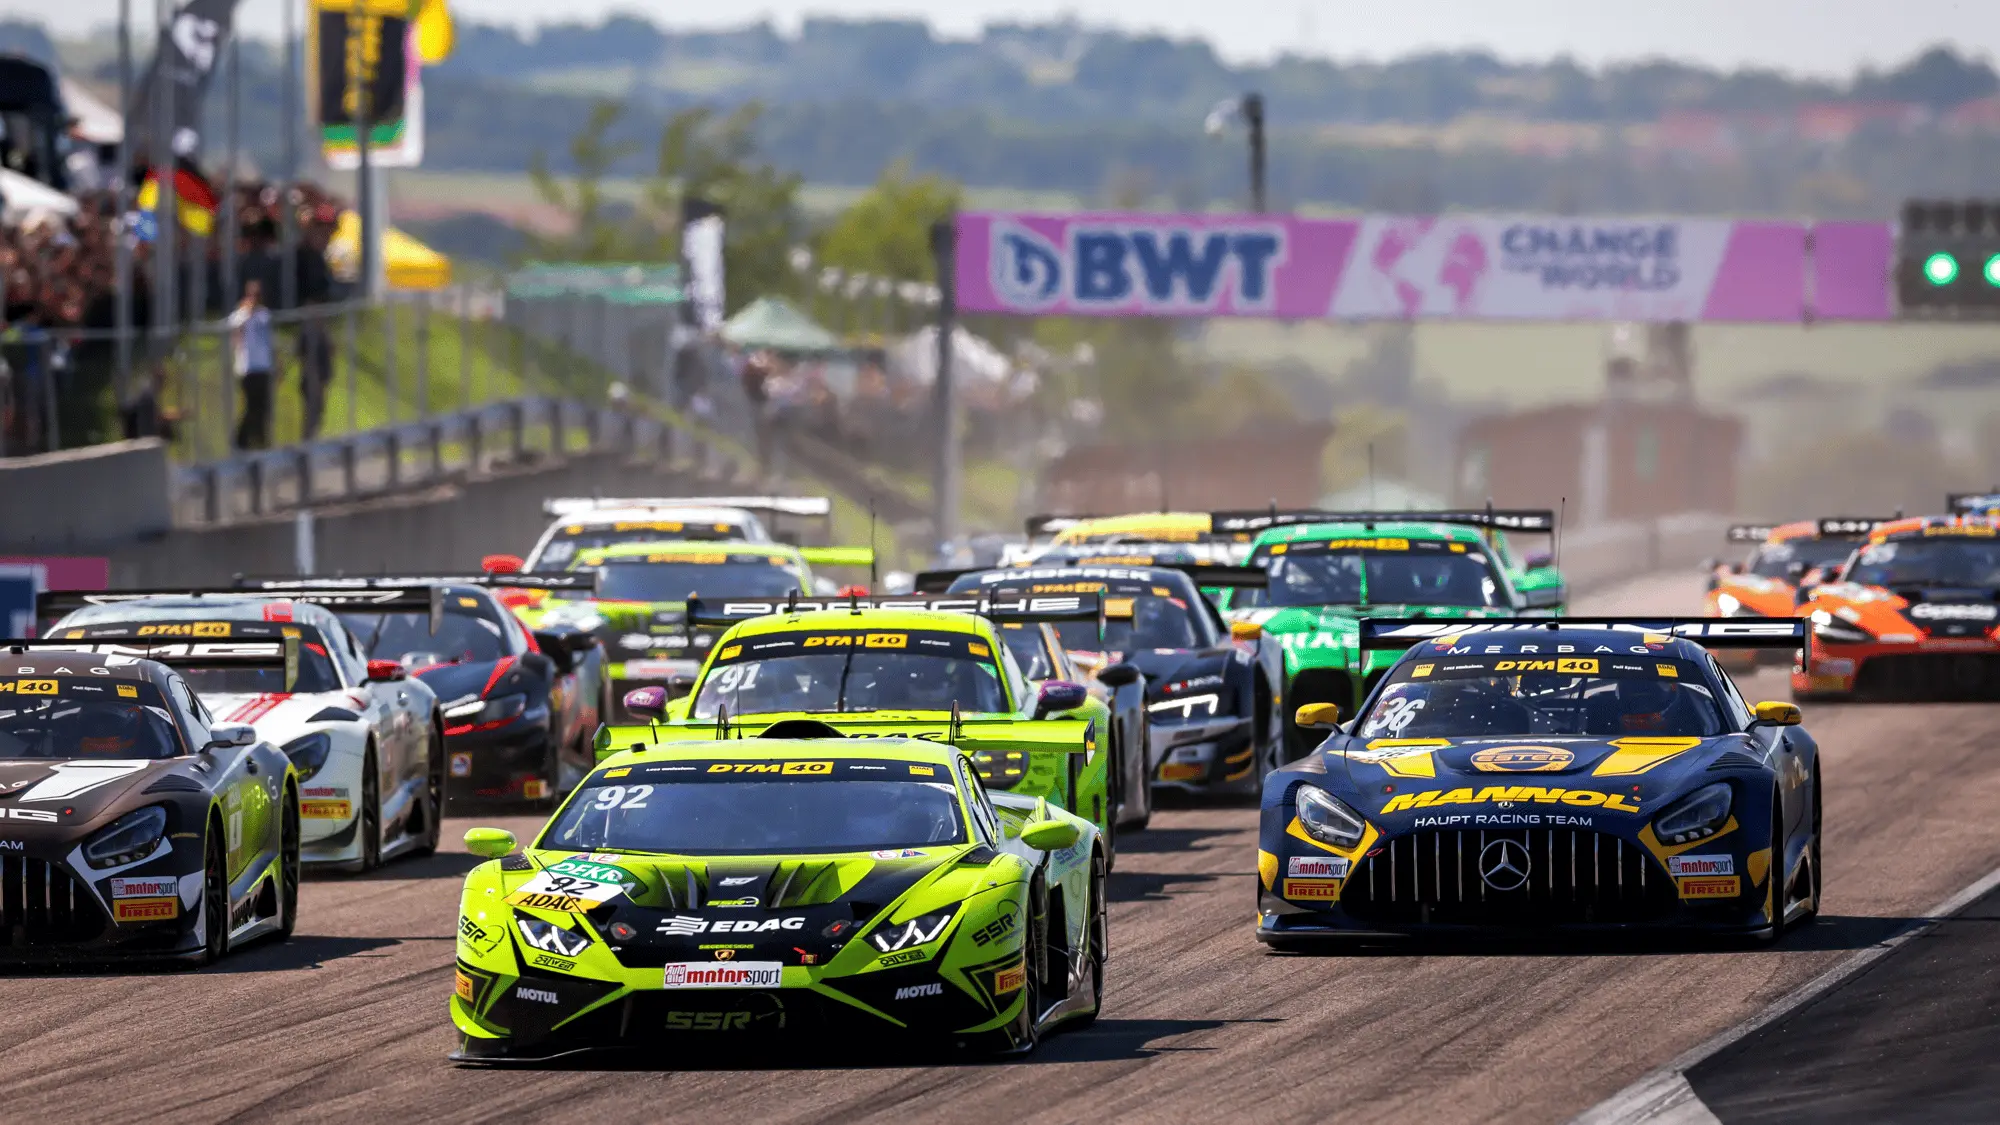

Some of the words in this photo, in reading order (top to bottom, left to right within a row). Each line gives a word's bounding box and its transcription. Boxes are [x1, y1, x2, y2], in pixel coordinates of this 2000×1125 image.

[1503, 224, 1676, 257] CHANGE
[1074, 229, 1278, 304] BWT
[1542, 264, 1681, 291] WORLD
[137, 624, 192, 636] DTM
[198, 623, 224, 635] 40
[802, 635, 865, 647] DTM
[871, 636, 901, 644] 40
[1446, 644, 1651, 655] MERBAG
[1494, 660, 1555, 671] DTM
[1561, 661, 1594, 671] 40
[22, 682, 53, 692] 40
[717, 663, 762, 694] 91
[1372, 696, 1426, 732] 36
[706, 764, 780, 773] DTM
[789, 763, 827, 772] 40
[594, 784, 655, 811] 92
[1380, 786, 1641, 815] MANNOL
[1414, 815, 1471, 827] HAUPT
[1475, 814, 1541, 824] RACING
[1546, 815, 1592, 826] TEAM
[1299, 861, 1347, 877] motorsport
[1680, 859, 1733, 874] motorsport
[125, 881, 177, 895] motorsport
[545, 876, 599, 896] 92
[1287, 882, 1335, 897] PIRELLI
[1683, 879, 1736, 895] PIRELLI
[119, 902, 173, 918] PIRELLI
[517, 893, 581, 911] ADAC
[459, 915, 488, 943] SSR
[709, 917, 806, 933] EDAG
[971, 912, 1016, 948] SSR
[686, 967, 781, 985] motorsport
[516, 987, 559, 1005] MOTUL
[895, 983, 943, 1001] MOTUL
[664, 1010, 752, 1030] SSR
